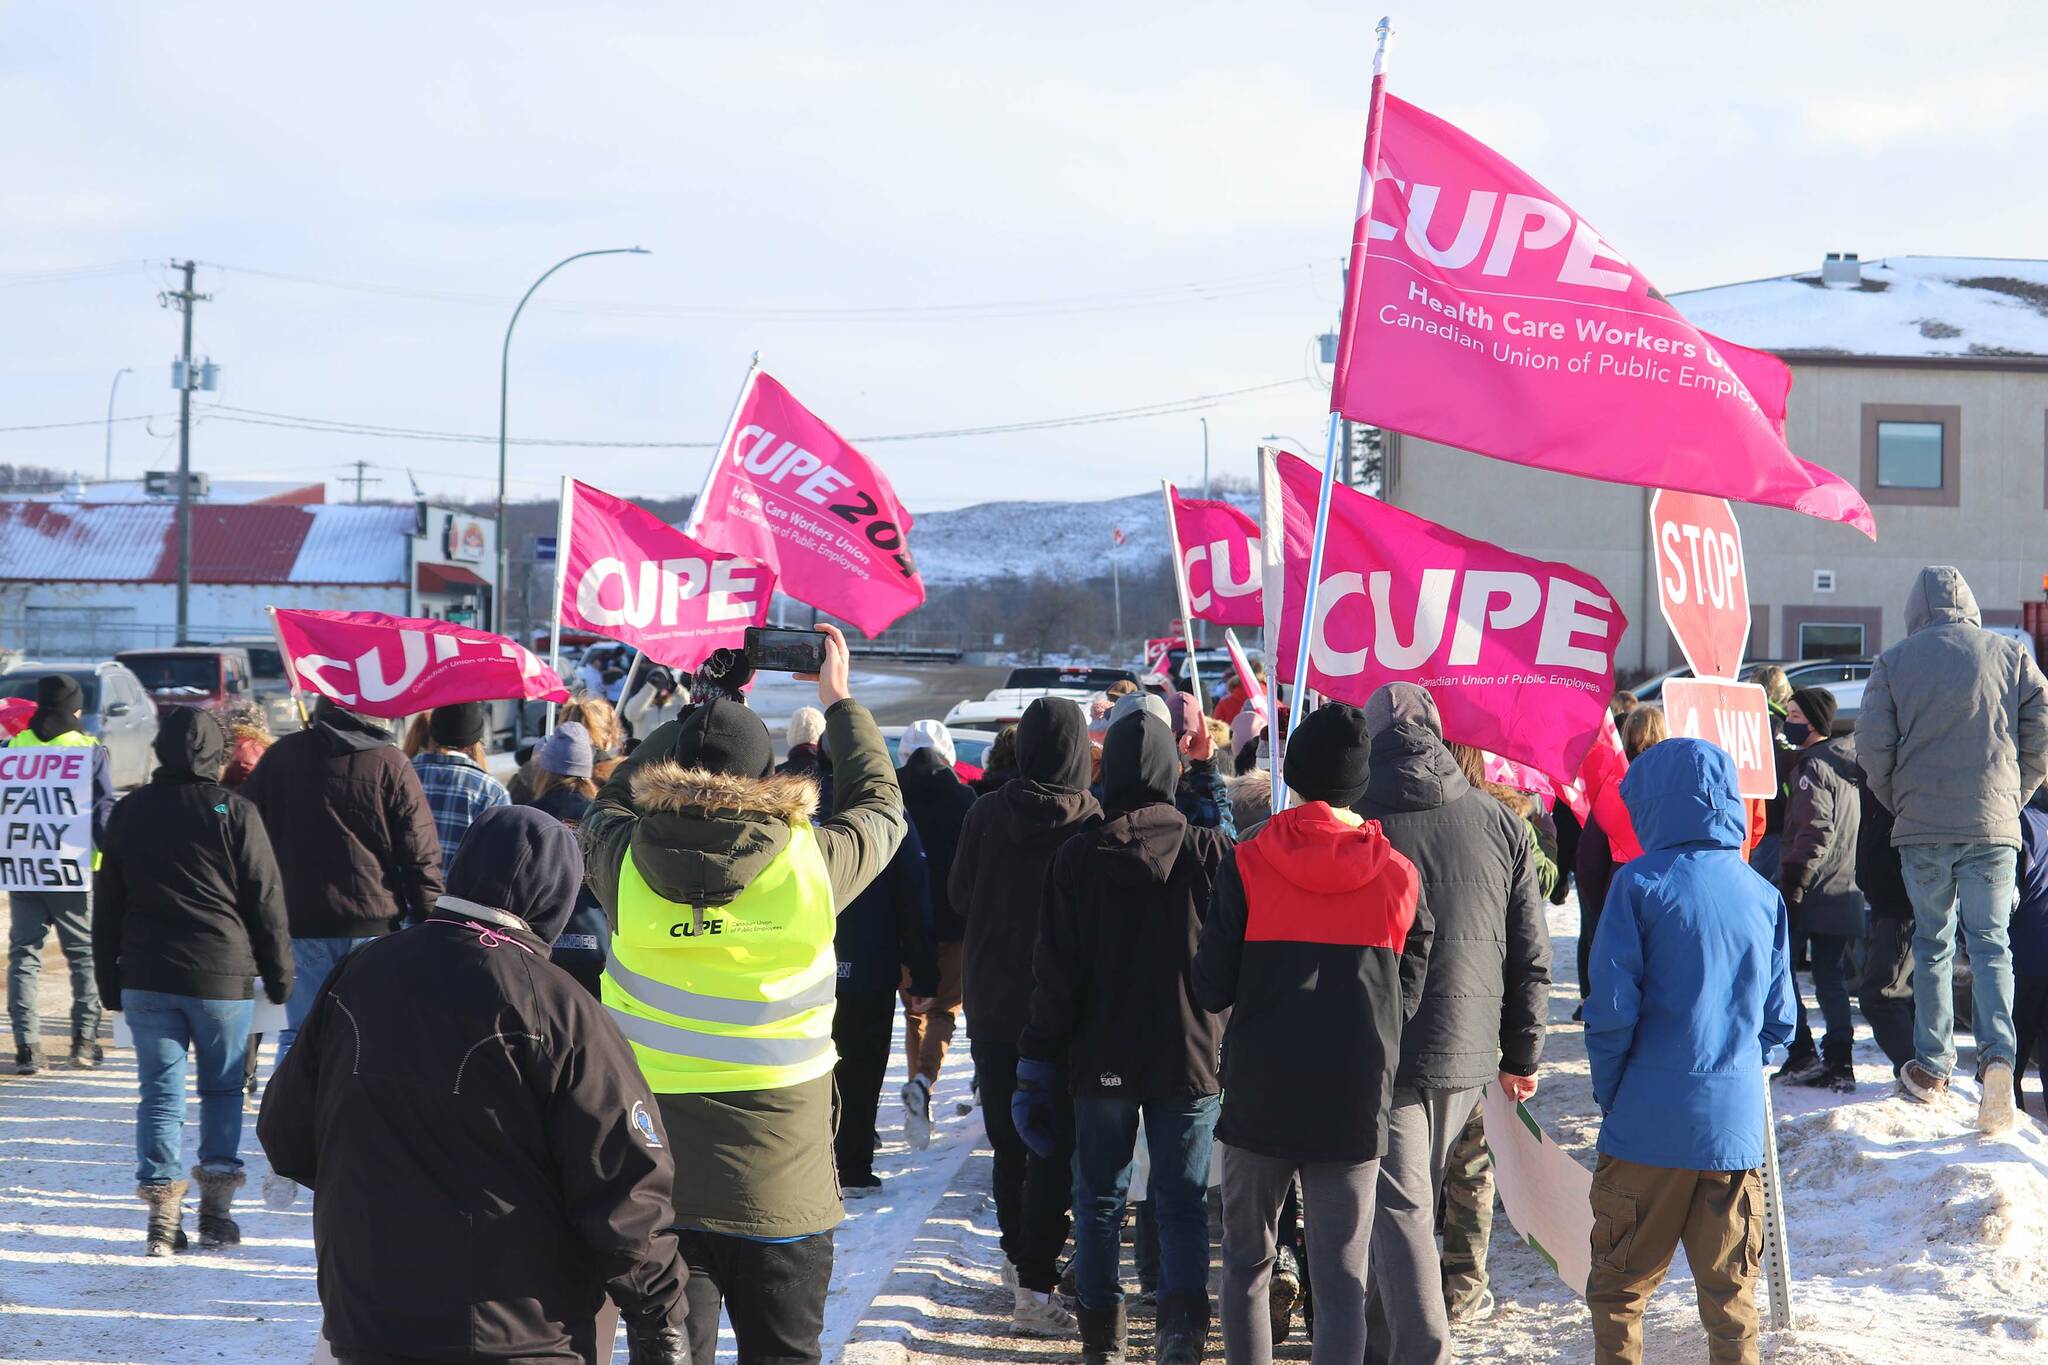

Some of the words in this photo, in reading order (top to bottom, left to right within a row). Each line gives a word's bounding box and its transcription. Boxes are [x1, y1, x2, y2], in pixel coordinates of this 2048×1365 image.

[1355, 158, 1633, 292] CUPE
[1379, 304, 1485, 353] Canadian
[1492, 341, 1560, 371] Union
[1567, 351, 1593, 374] of
[1599, 353, 1671, 384] Public
[1408, 280, 1494, 331] Health
[1502, 311, 1566, 341] Care
[1575, 318, 1697, 359] Workers
[732, 424, 855, 505] CUPE
[766, 501, 787, 520] Care
[790, 512, 833, 540] Workers
[835, 535, 871, 566] Union
[790, 532, 817, 551] Public
[817, 544, 870, 580] Employees
[1661, 520, 1738, 611] STOP
[1310, 568, 1613, 677] CUPE
[450, 657, 475, 667] Union
[1418, 677, 1458, 688] Canadian
[1462, 674, 1494, 686] Union
[1497, 673, 1509, 685] of
[1511, 673, 1546, 685] Public
[1549, 674, 1601, 694] Employees
[0, 754, 84, 780] CUPE
[1714, 707, 1763, 771] WAY
[0, 786, 78, 815] FAIR
[6, 822, 70, 851] PAY
[1100, 1077, 1122, 1087] 509
